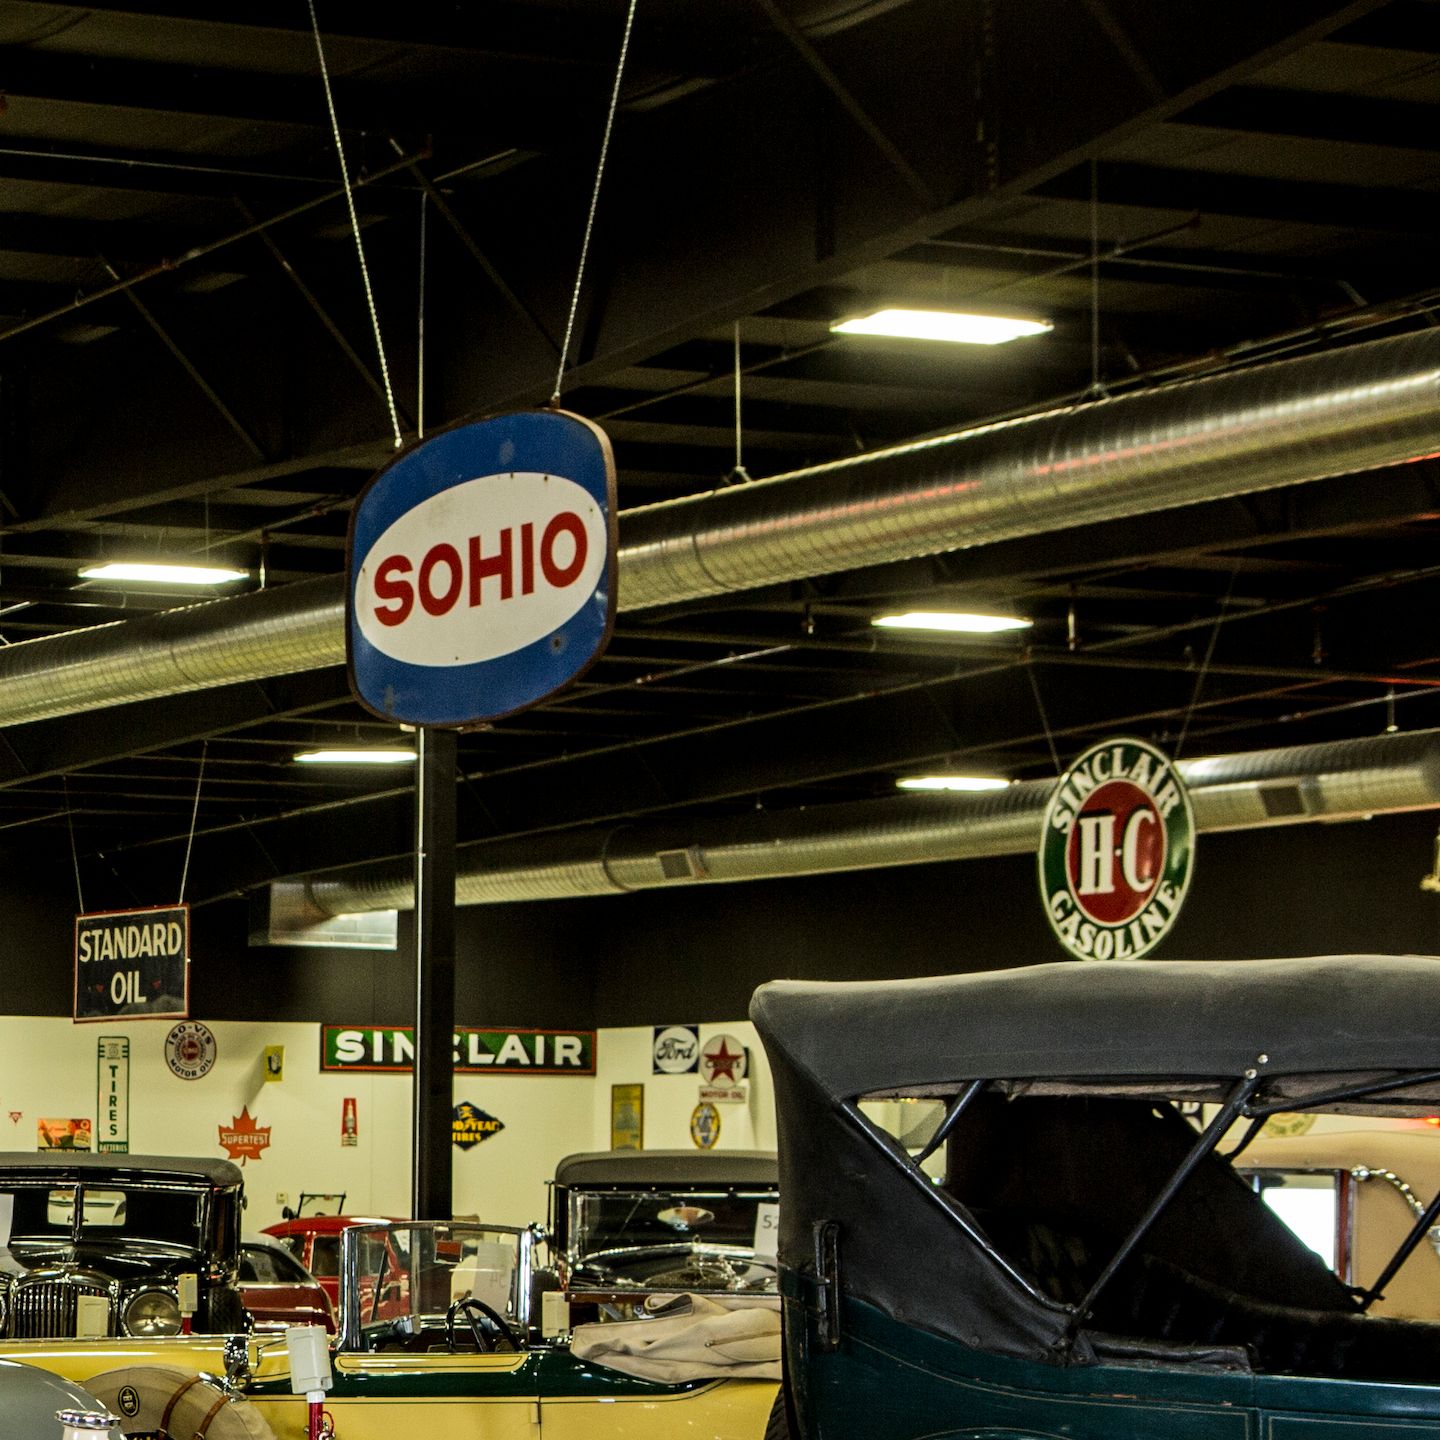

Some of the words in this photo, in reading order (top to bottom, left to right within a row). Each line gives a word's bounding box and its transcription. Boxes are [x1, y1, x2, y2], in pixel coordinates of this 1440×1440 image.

[374, 511, 588, 627] SOHIO
[1052, 747, 1180, 834] SINCLAIR
[1051, 880, 1182, 960] GASOLINE
[79, 922, 182, 962] STANDARD
[110, 970, 147, 1004] OIL
[168, 1023, 212, 1045] ISO-VIS
[335, 1030, 583, 1066] SINLAIR
[656, 1037, 696, 1061] Ford
[170, 1058, 197, 1077] MOTOR
[199, 1059, 212, 1073] OIL
[109, 1064, 118, 1136] TIRES
[701, 1089, 728, 1099] MOTOR
[730, 1090, 745, 1099] OIL
[99, 1144, 128, 1153] BATTERIES
[221, 1132, 269, 1146] SUPERTEST
[452, 1132, 482, 1142] TIRES
